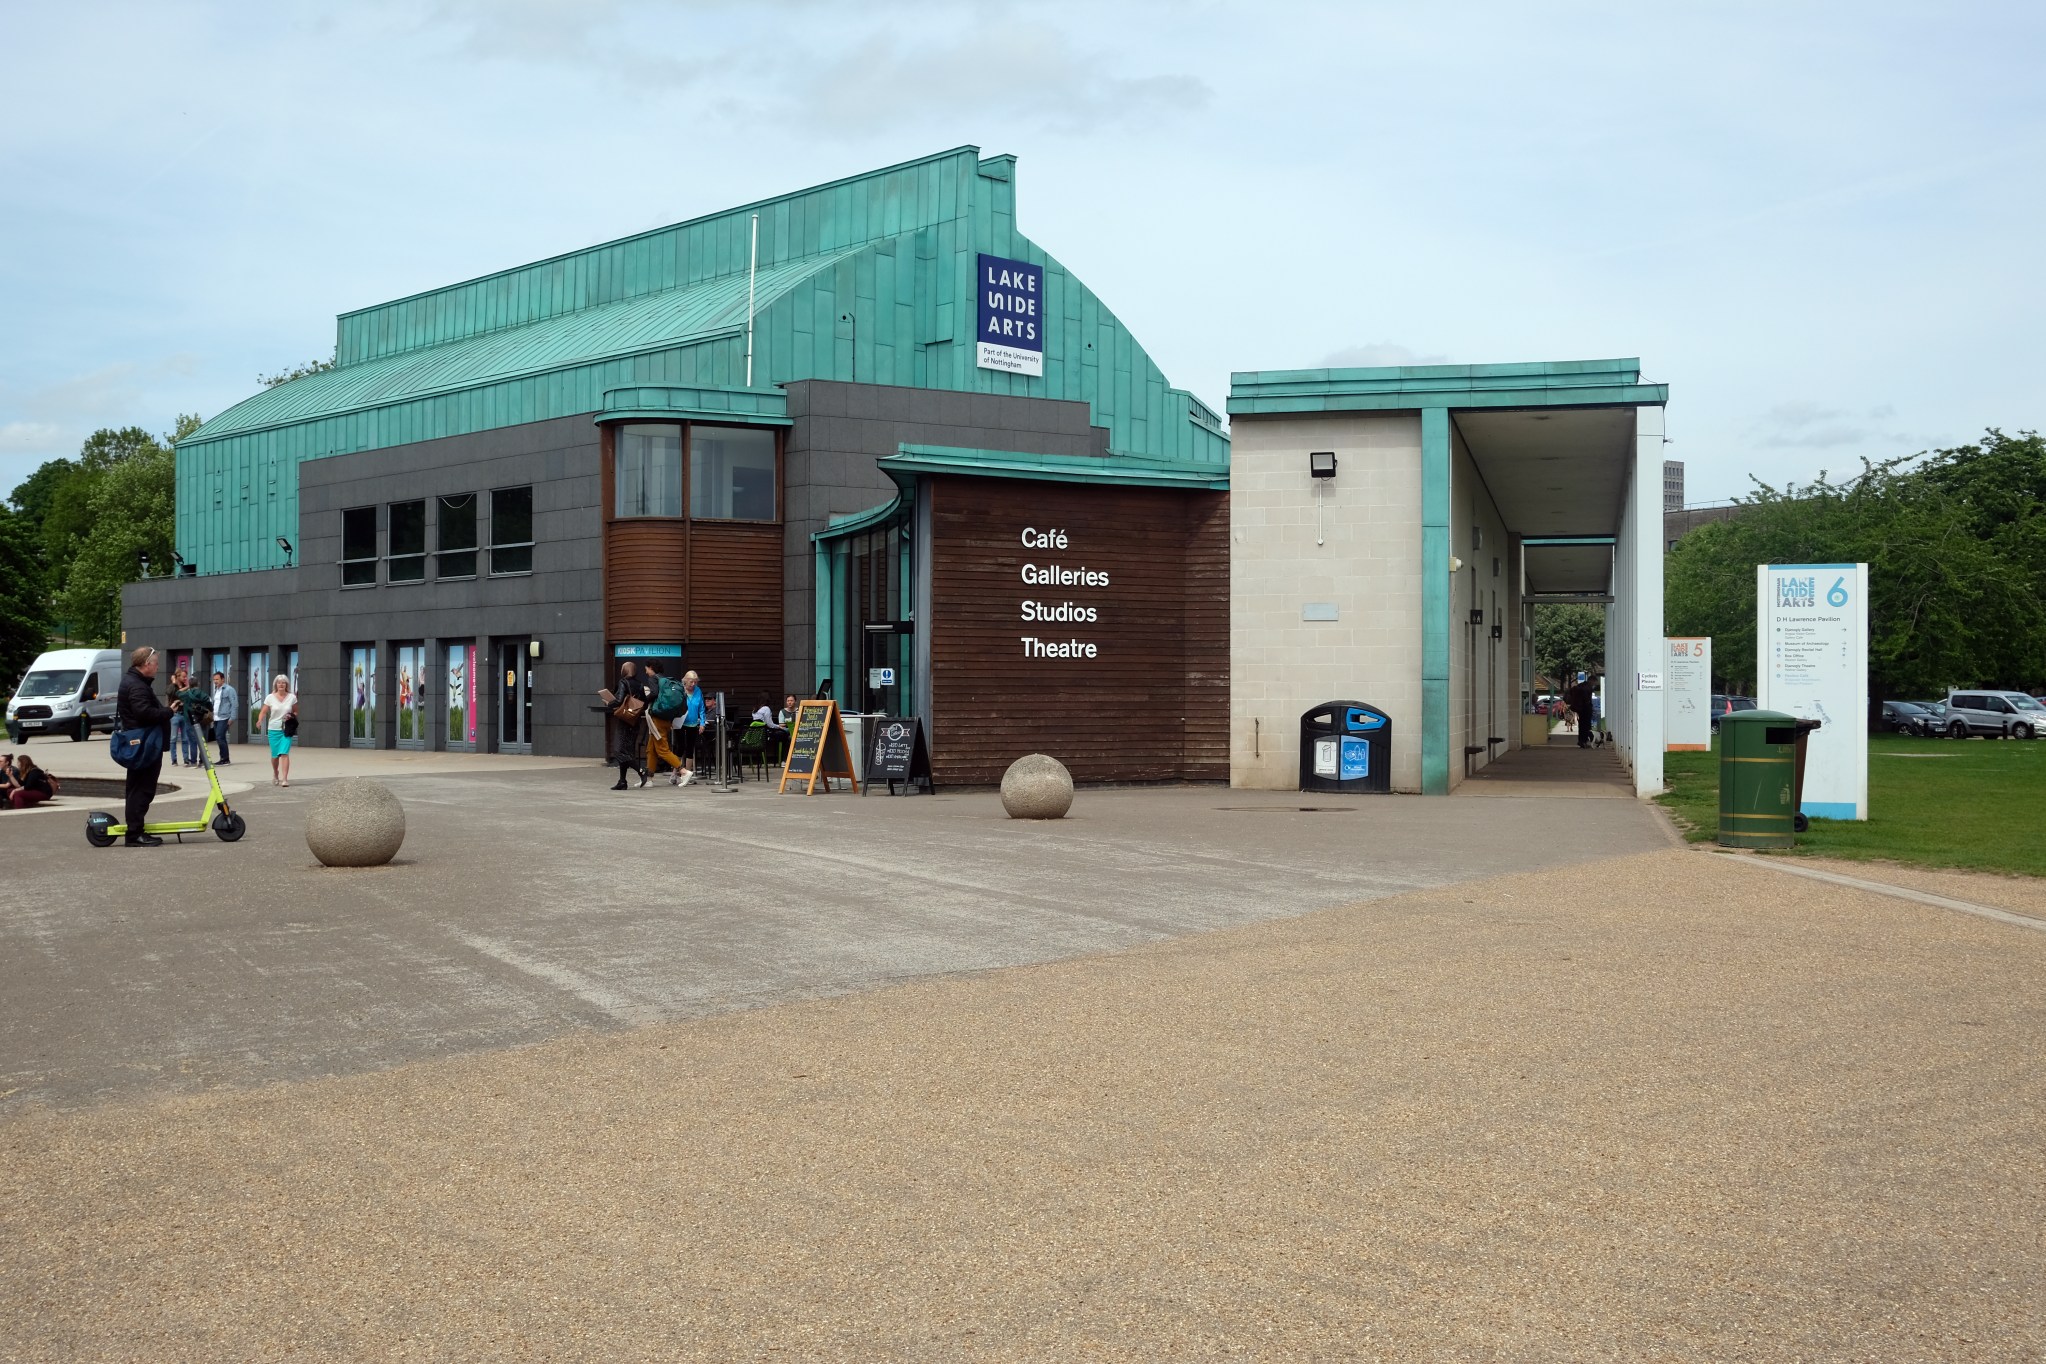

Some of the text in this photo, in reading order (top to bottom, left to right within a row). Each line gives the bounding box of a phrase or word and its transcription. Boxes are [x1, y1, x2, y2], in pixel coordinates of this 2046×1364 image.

[988, 266, 1036, 292] LAKE
[988, 290, 1036, 316] SIDE
[987, 316, 1036, 340] ARTS
[983, 347, 995, 356] Part
[1002, 350, 1012, 358] the
[1012, 353, 1040, 365] University
[990, 357, 1022, 369] Nottingham
[1021, 527, 1068, 549] Café
[1021, 563, 1109, 587] Galleries
[1781, 577, 1815, 588] LAKE
[1781, 597, 1815, 608] ARTS
[1826, 576, 1849, 608] 6
[1020, 600, 1097, 622] Studios
[635, 646, 671, 655] PAVILION
[1020, 637, 1097, 659] Theatre
[1693, 642, 1703, 657] 5
